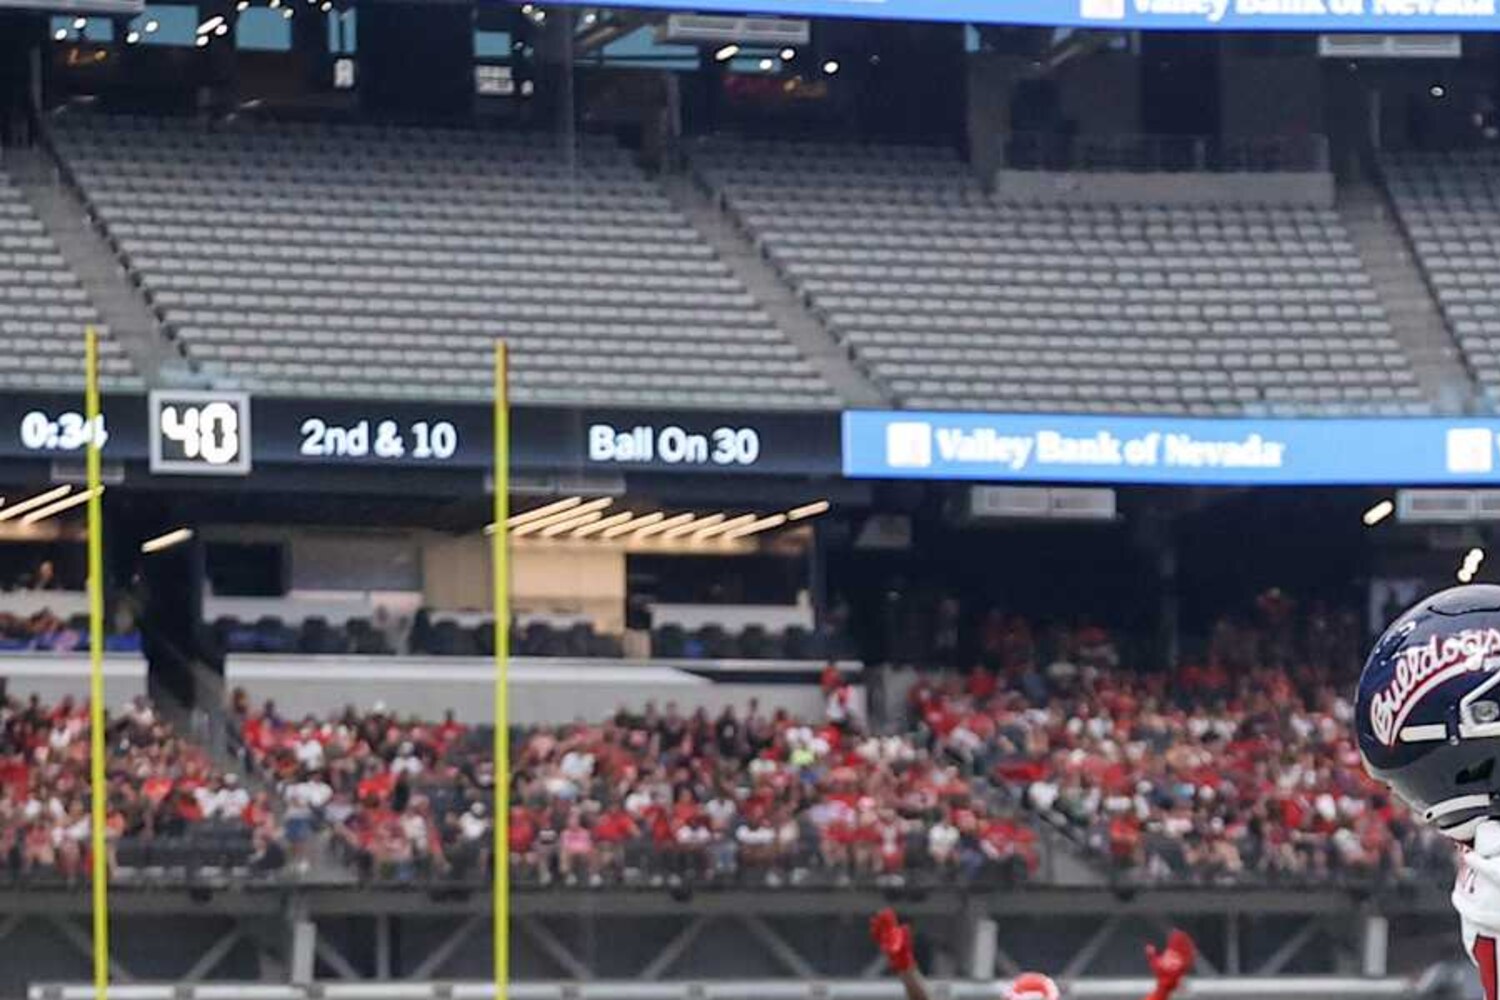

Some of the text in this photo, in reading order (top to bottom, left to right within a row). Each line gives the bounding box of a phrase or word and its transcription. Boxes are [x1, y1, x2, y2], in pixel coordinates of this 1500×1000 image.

[20, 411, 108, 450] 0:34
[161, 402, 238, 465] 40
[300, 418, 457, 459] 2nd & 10
[588, 424, 759, 464] Ball On 30
[936, 428, 1285, 470] Valley Bank of Nevada
